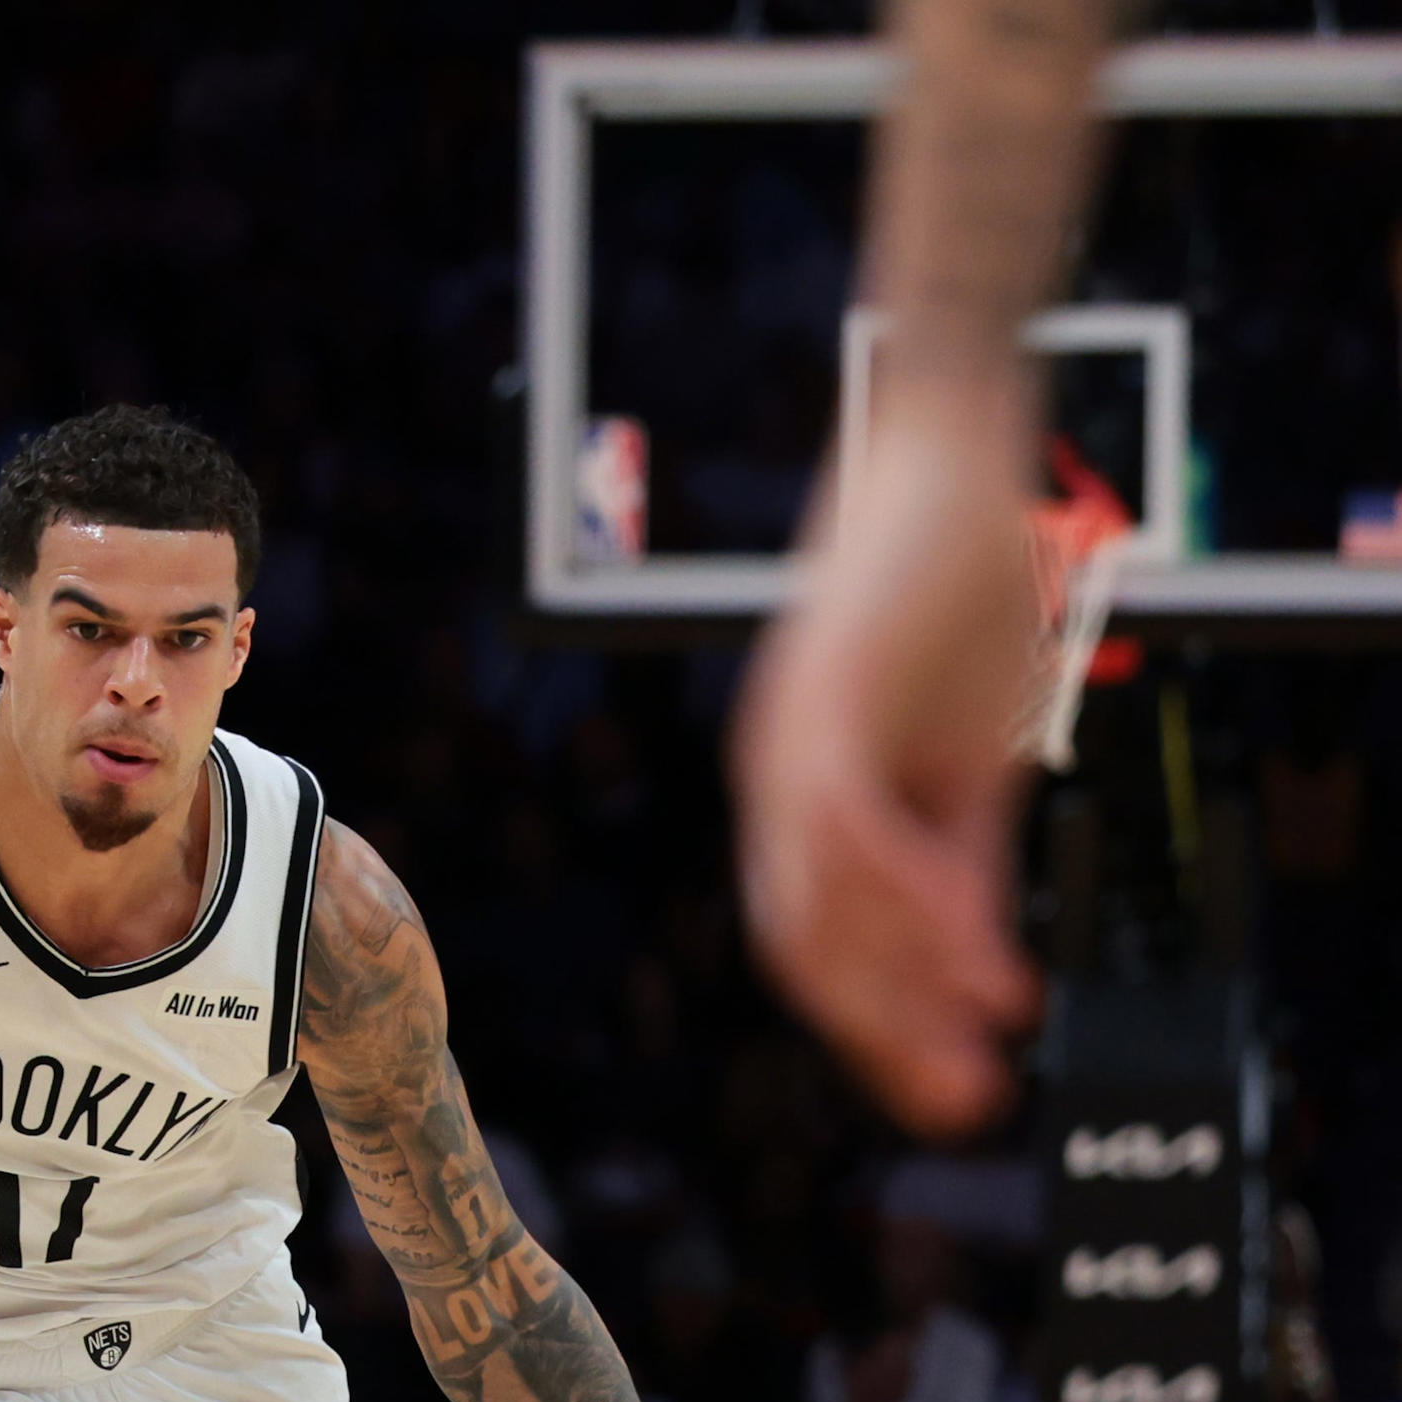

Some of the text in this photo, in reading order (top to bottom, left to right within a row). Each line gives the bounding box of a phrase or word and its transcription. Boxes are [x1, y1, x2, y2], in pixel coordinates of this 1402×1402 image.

[164, 992, 260, 1021] All In Won
[408, 1240, 560, 1363] LOVE
[87, 1323, 131, 1354] NETS
